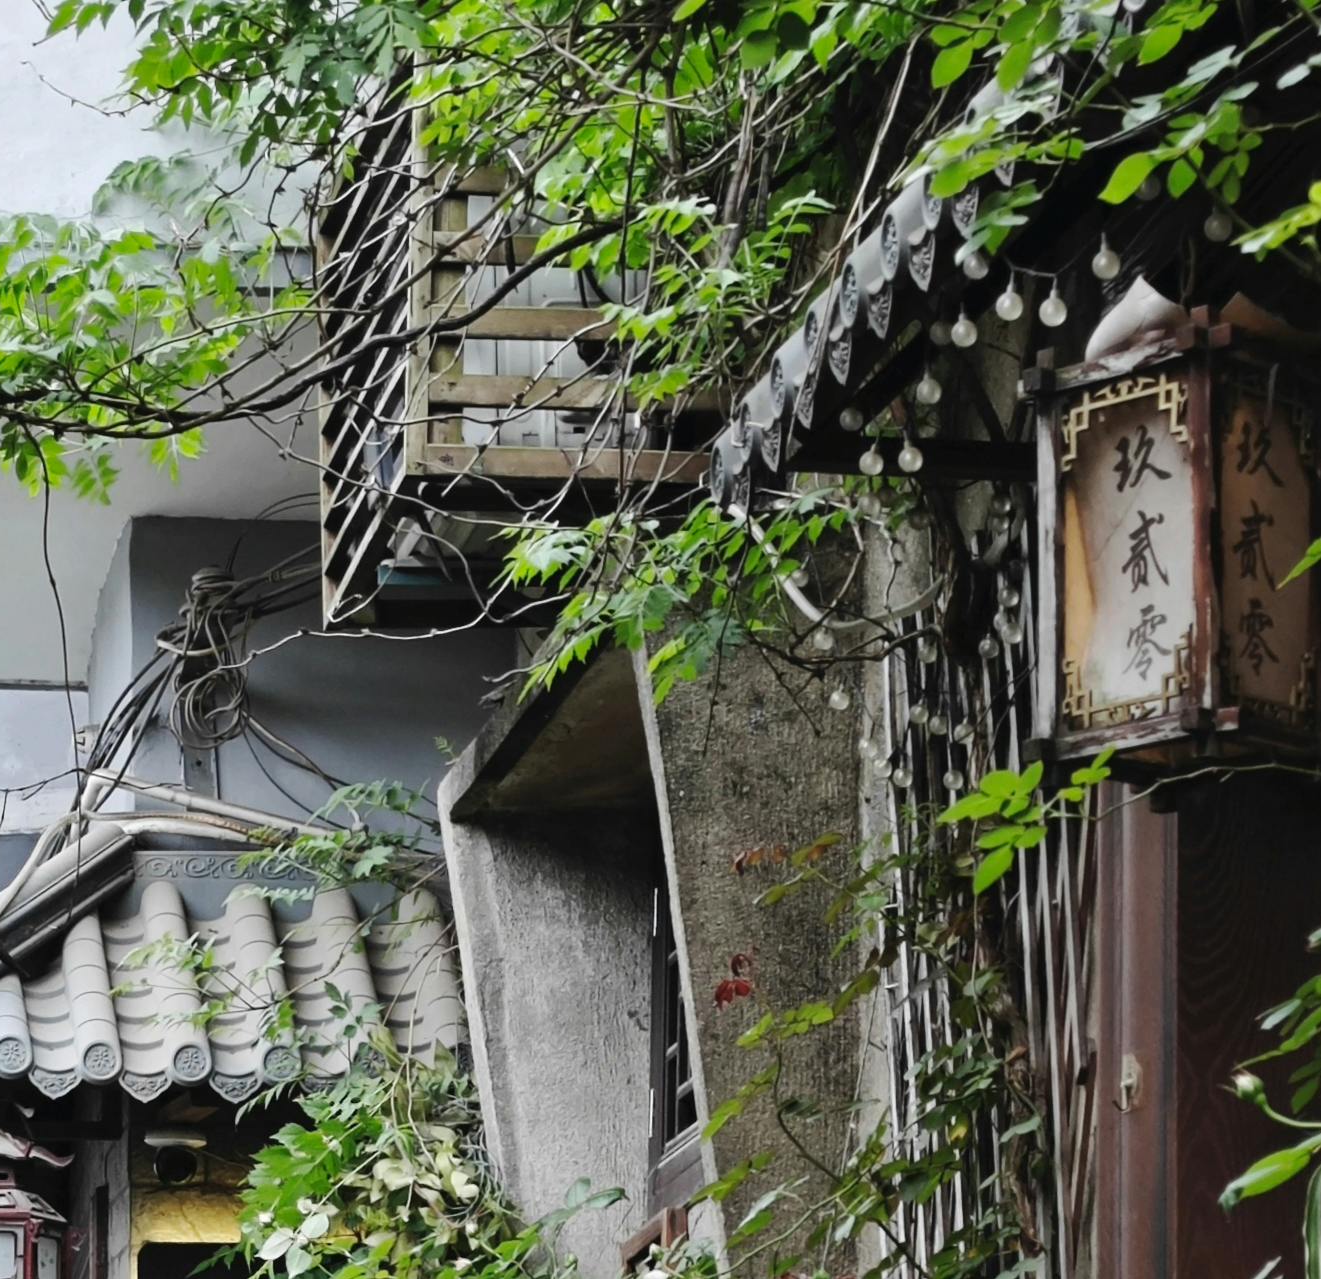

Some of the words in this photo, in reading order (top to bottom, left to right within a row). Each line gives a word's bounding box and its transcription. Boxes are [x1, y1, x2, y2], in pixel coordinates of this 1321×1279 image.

[1112, 424, 1173, 682] 玖贰零
[1231, 421, 1286, 677] 玖贰零
